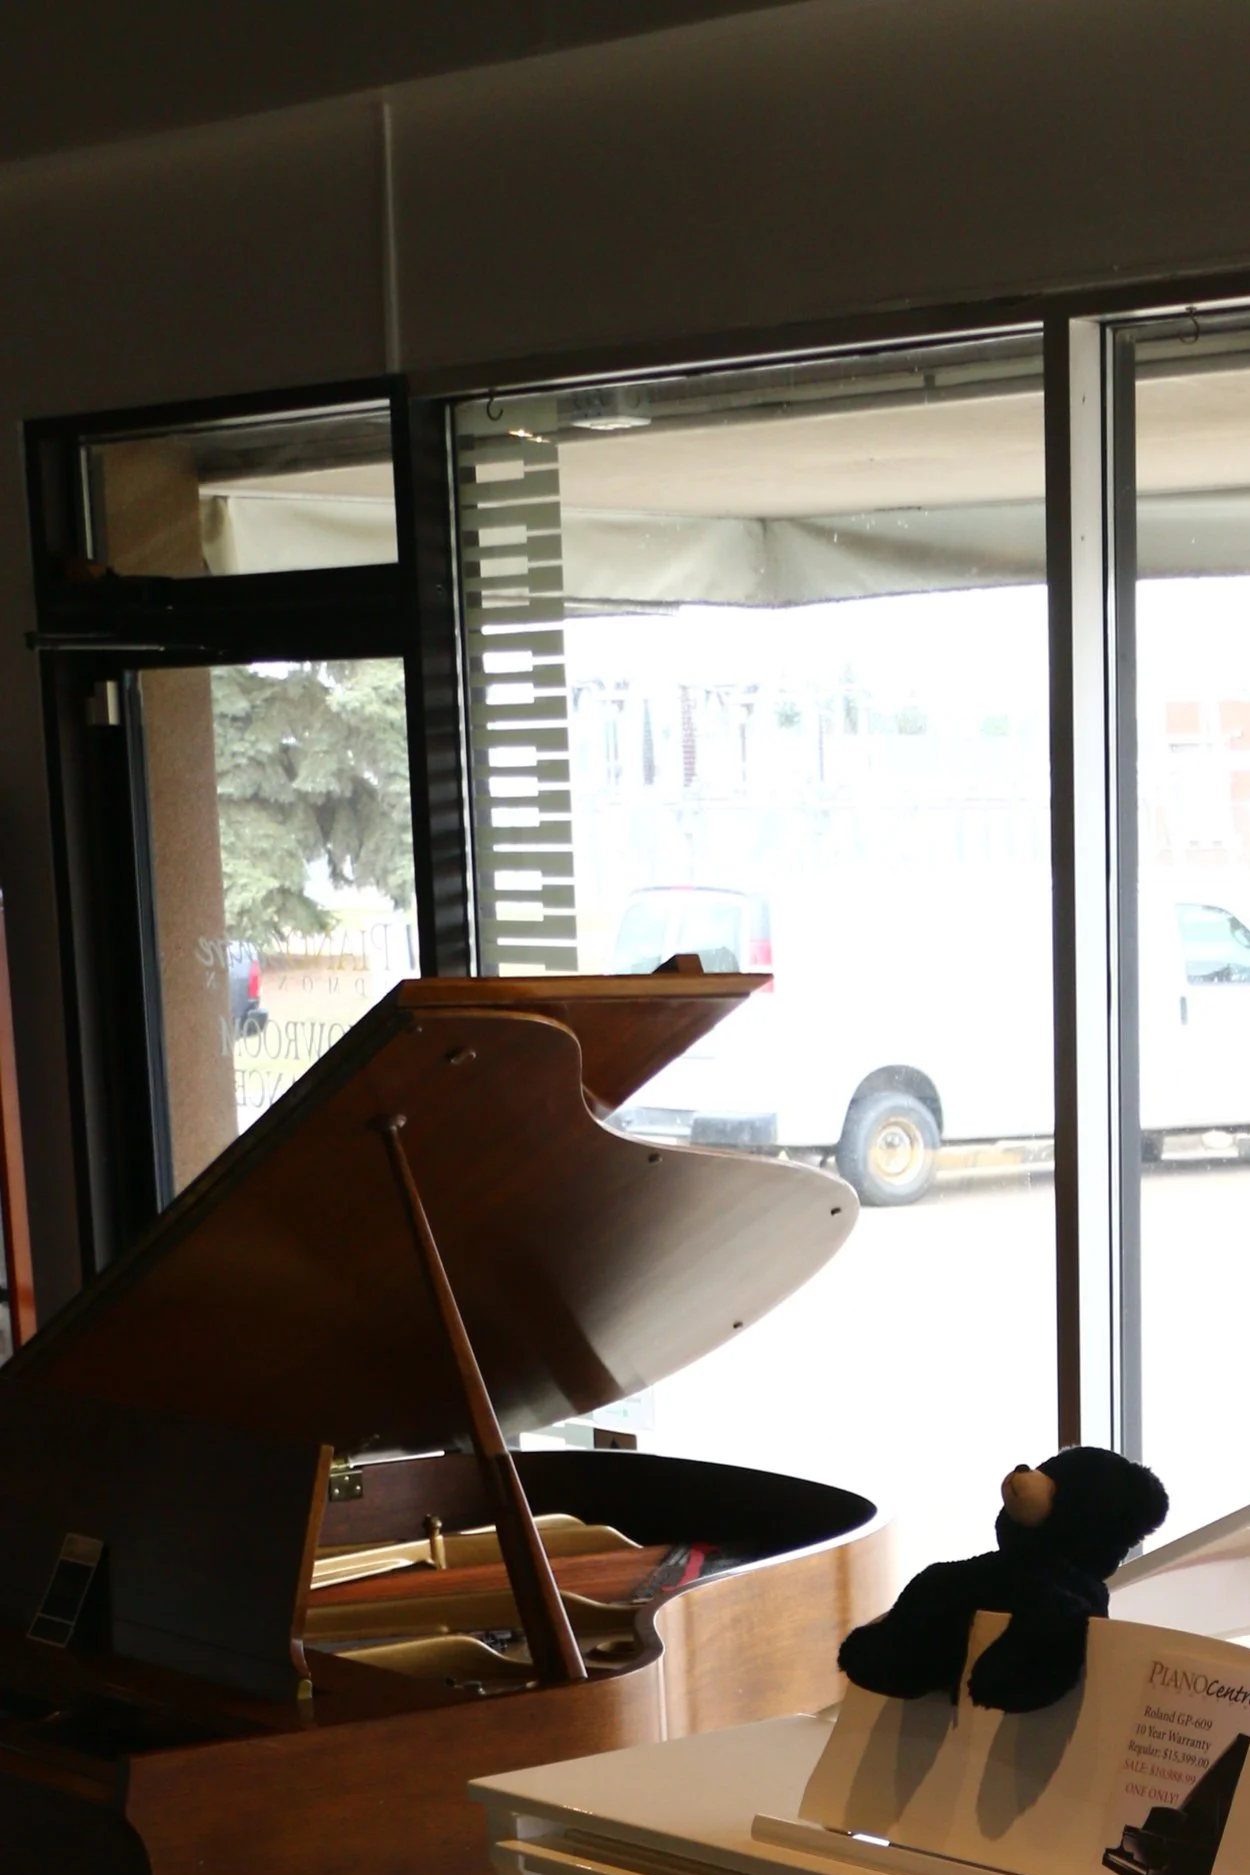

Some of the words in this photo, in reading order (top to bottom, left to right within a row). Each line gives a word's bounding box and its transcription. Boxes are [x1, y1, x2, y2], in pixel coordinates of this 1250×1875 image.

[1144, 1705, 1176, 1724] Roland
[1177, 1713, 1213, 1731] GP-609
[1135, 1723, 1147, 1735] 10
[1148, 1725, 1167, 1741] Year
[1168, 1730, 1213, 1754] Warranty
[1124, 1782, 1148, 1798] ONE
[1148, 1788, 1180, 1805] ONLY!
